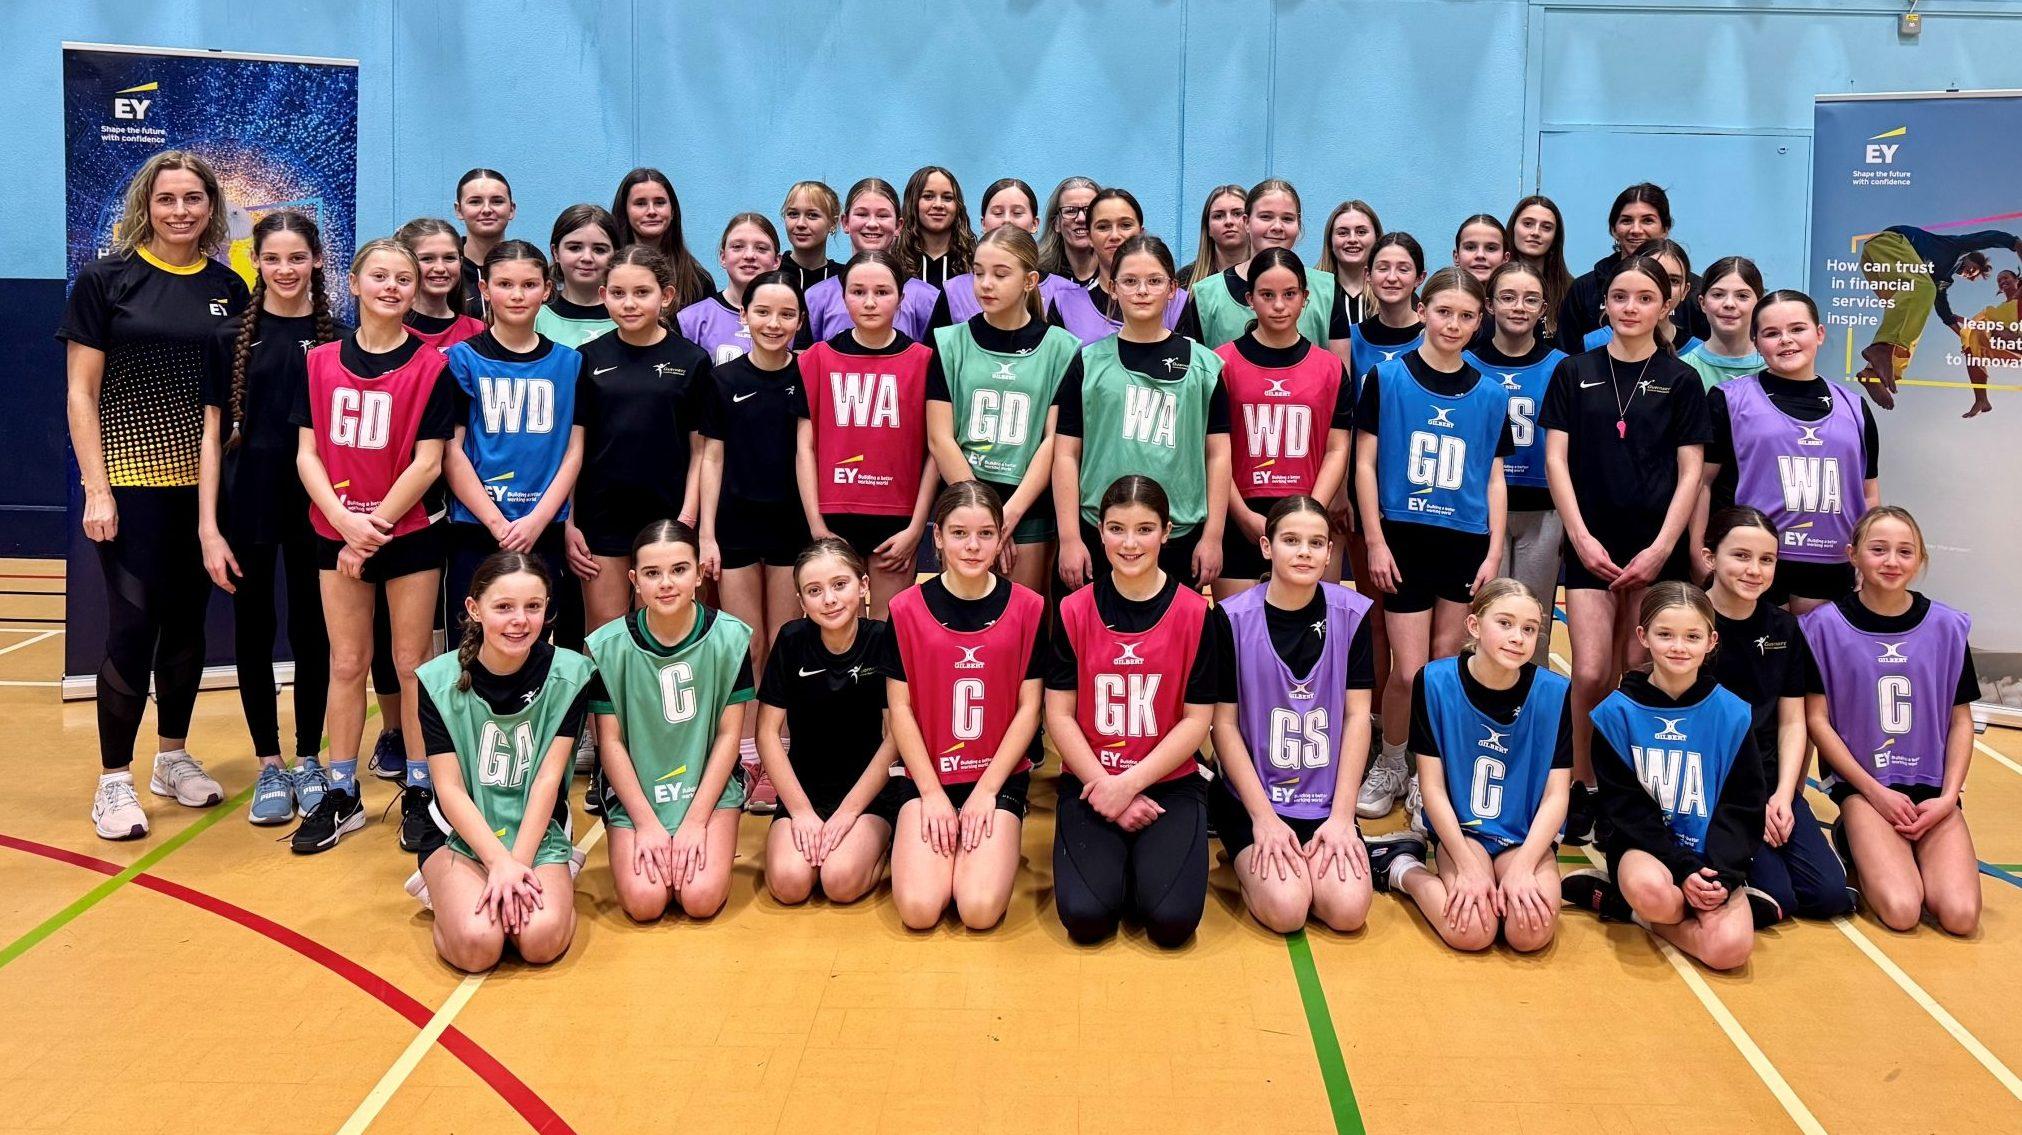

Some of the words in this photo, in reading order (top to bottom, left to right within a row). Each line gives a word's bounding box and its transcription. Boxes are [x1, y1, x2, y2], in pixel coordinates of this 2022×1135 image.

[115, 98, 150, 120] EY
[101, 126, 125, 134] Shape
[142, 127, 165, 135] future
[122, 135, 165, 143] confidence
[1865, 144, 1900, 164] EY
[1827, 259, 1859, 271] How
[1864, 261, 1891, 273] can
[1895, 261, 1935, 274] trust
[1832, 277, 1845, 289] in
[1850, 277, 1915, 291] financial
[1832, 295, 1896, 308] services
[1827, 312, 1878, 327] inspire
[1963, 317, 2005, 333] leaps
[1945, 352, 1961, 366] to
[479, 377, 554, 434] WD
[830, 372, 900, 428] WA
[330, 386, 392, 449] GD
[968, 388, 1030, 446] GD
[1122, 384, 1177, 448] WA
[1428, 420, 1455, 428] GILBERT
[1242, 404, 1312, 458] WD
[969, 451, 986, 466] EY
[1407, 430, 1466, 491] GD
[834, 468, 858, 484] EY
[1252, 471, 1271, 485] EY
[1777, 455, 1842, 514] WA
[484, 486, 508, 501] EY
[1408, 497, 1428, 511] EY
[1784, 531, 1809, 547] EY
[659, 661, 698, 724] C
[952, 677, 985, 741] C
[1094, 673, 1162, 737] GK
[1878, 675, 1912, 734] C
[1269, 707, 1329, 770] GS
[1478, 740, 1509, 754] GILBERT
[477, 720, 535, 788] GA
[1101, 750, 1121, 767] EY
[1874, 750, 1891, 768] EY
[940, 755, 961, 772] EY
[1470, 755, 1506, 820] C
[1630, 745, 1708, 818] WA
[261, 791, 286, 801] PUMA
[654, 782, 683, 804] EY
[1272, 787, 1296, 803] EY
